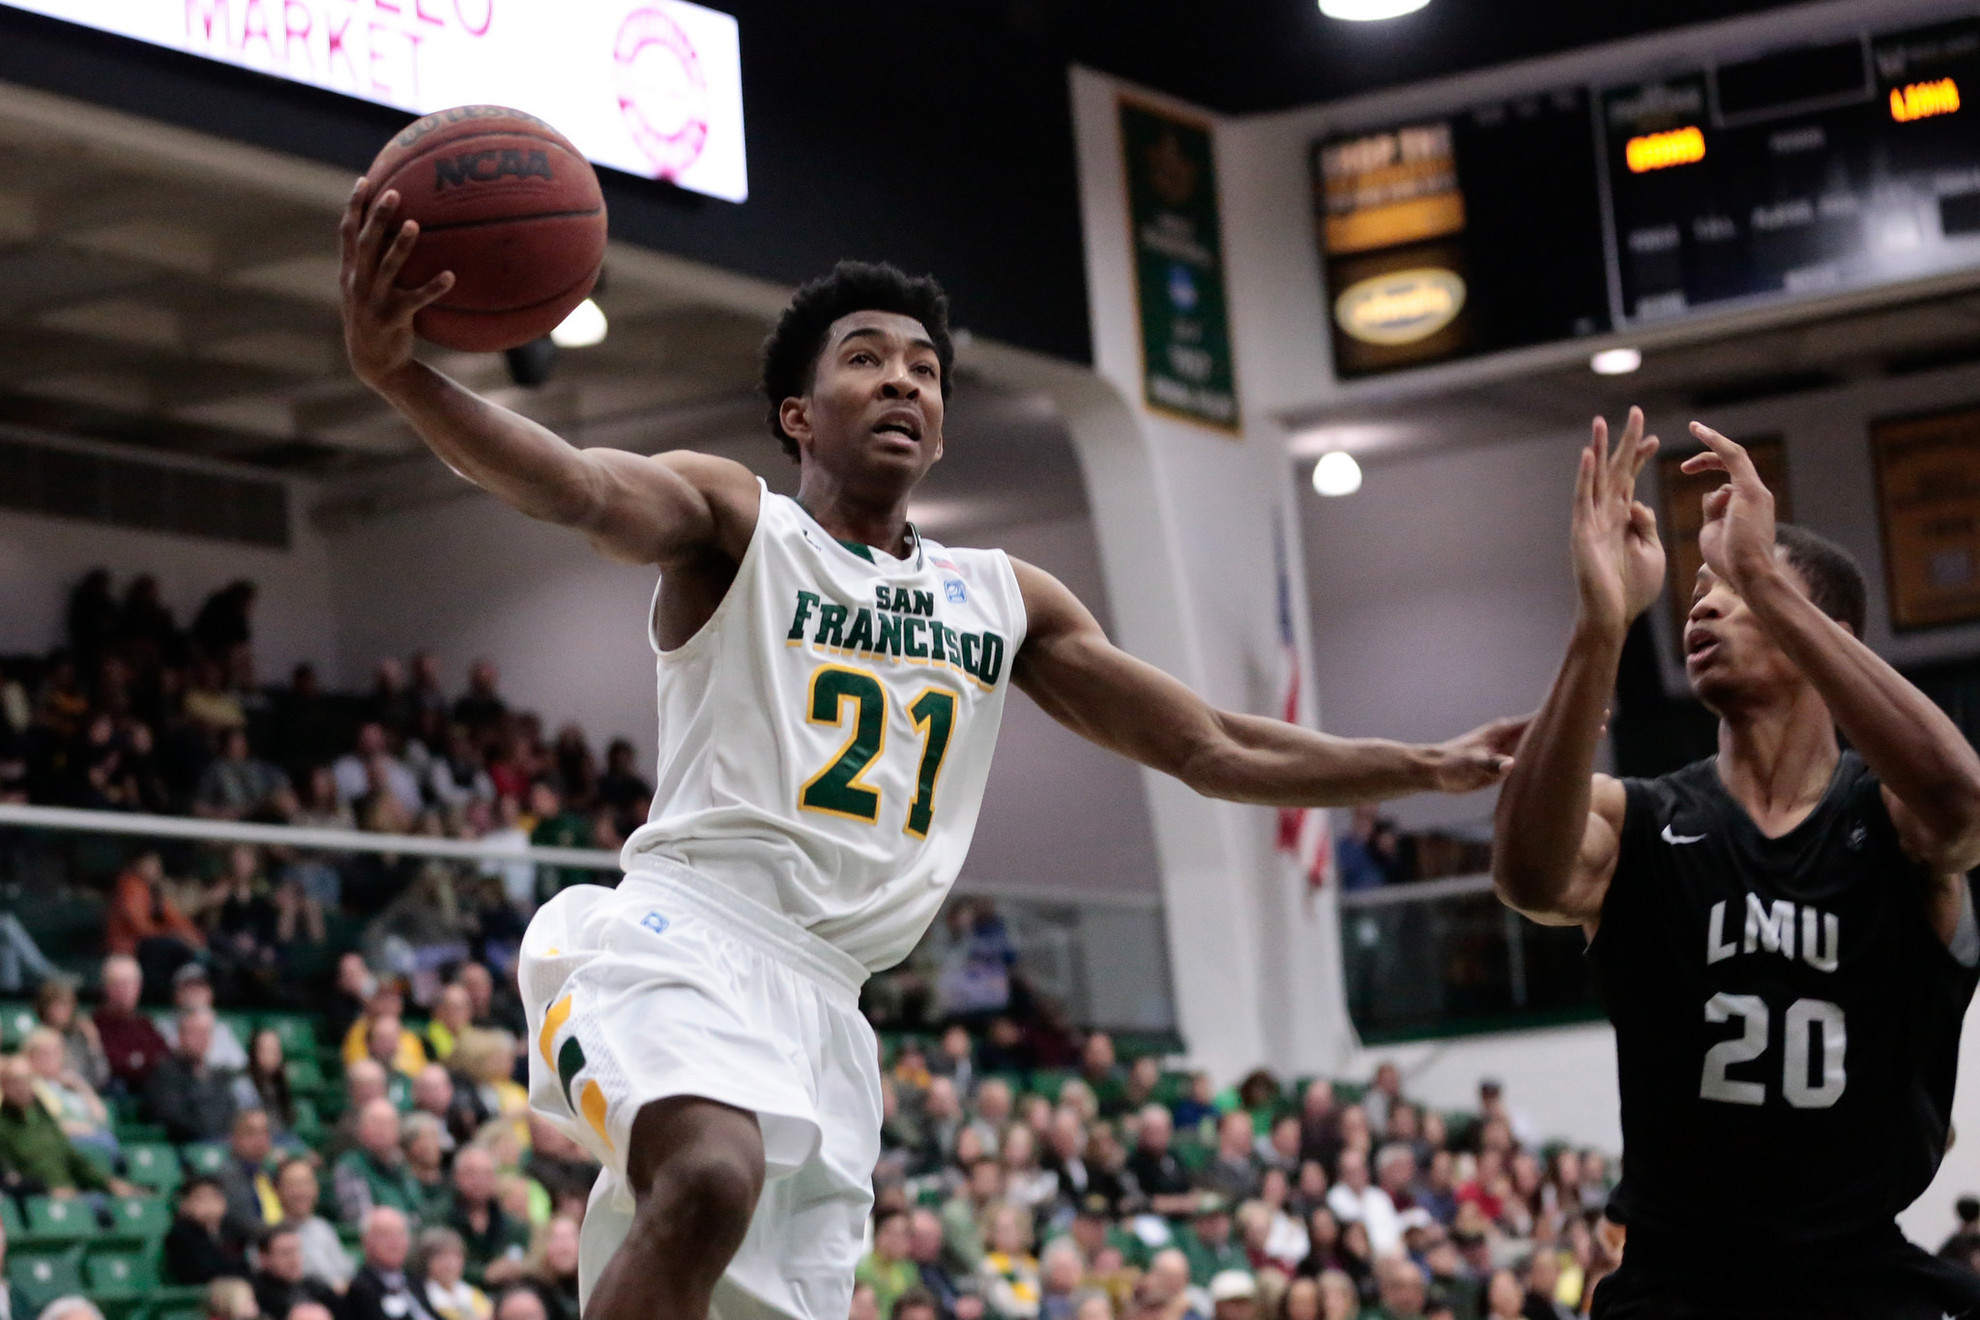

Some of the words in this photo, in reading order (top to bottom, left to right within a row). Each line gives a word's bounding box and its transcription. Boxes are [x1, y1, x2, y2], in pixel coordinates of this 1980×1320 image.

[184, 0, 424, 98] MARKET
[434, 149, 554, 192] NCAA
[786, 590, 1005, 692] FRANCISCO
[874, 585, 935, 617] SAN
[797, 662, 959, 841] 21
[1706, 891, 1839, 974] LMU
[1700, 991, 1848, 1109] 20
